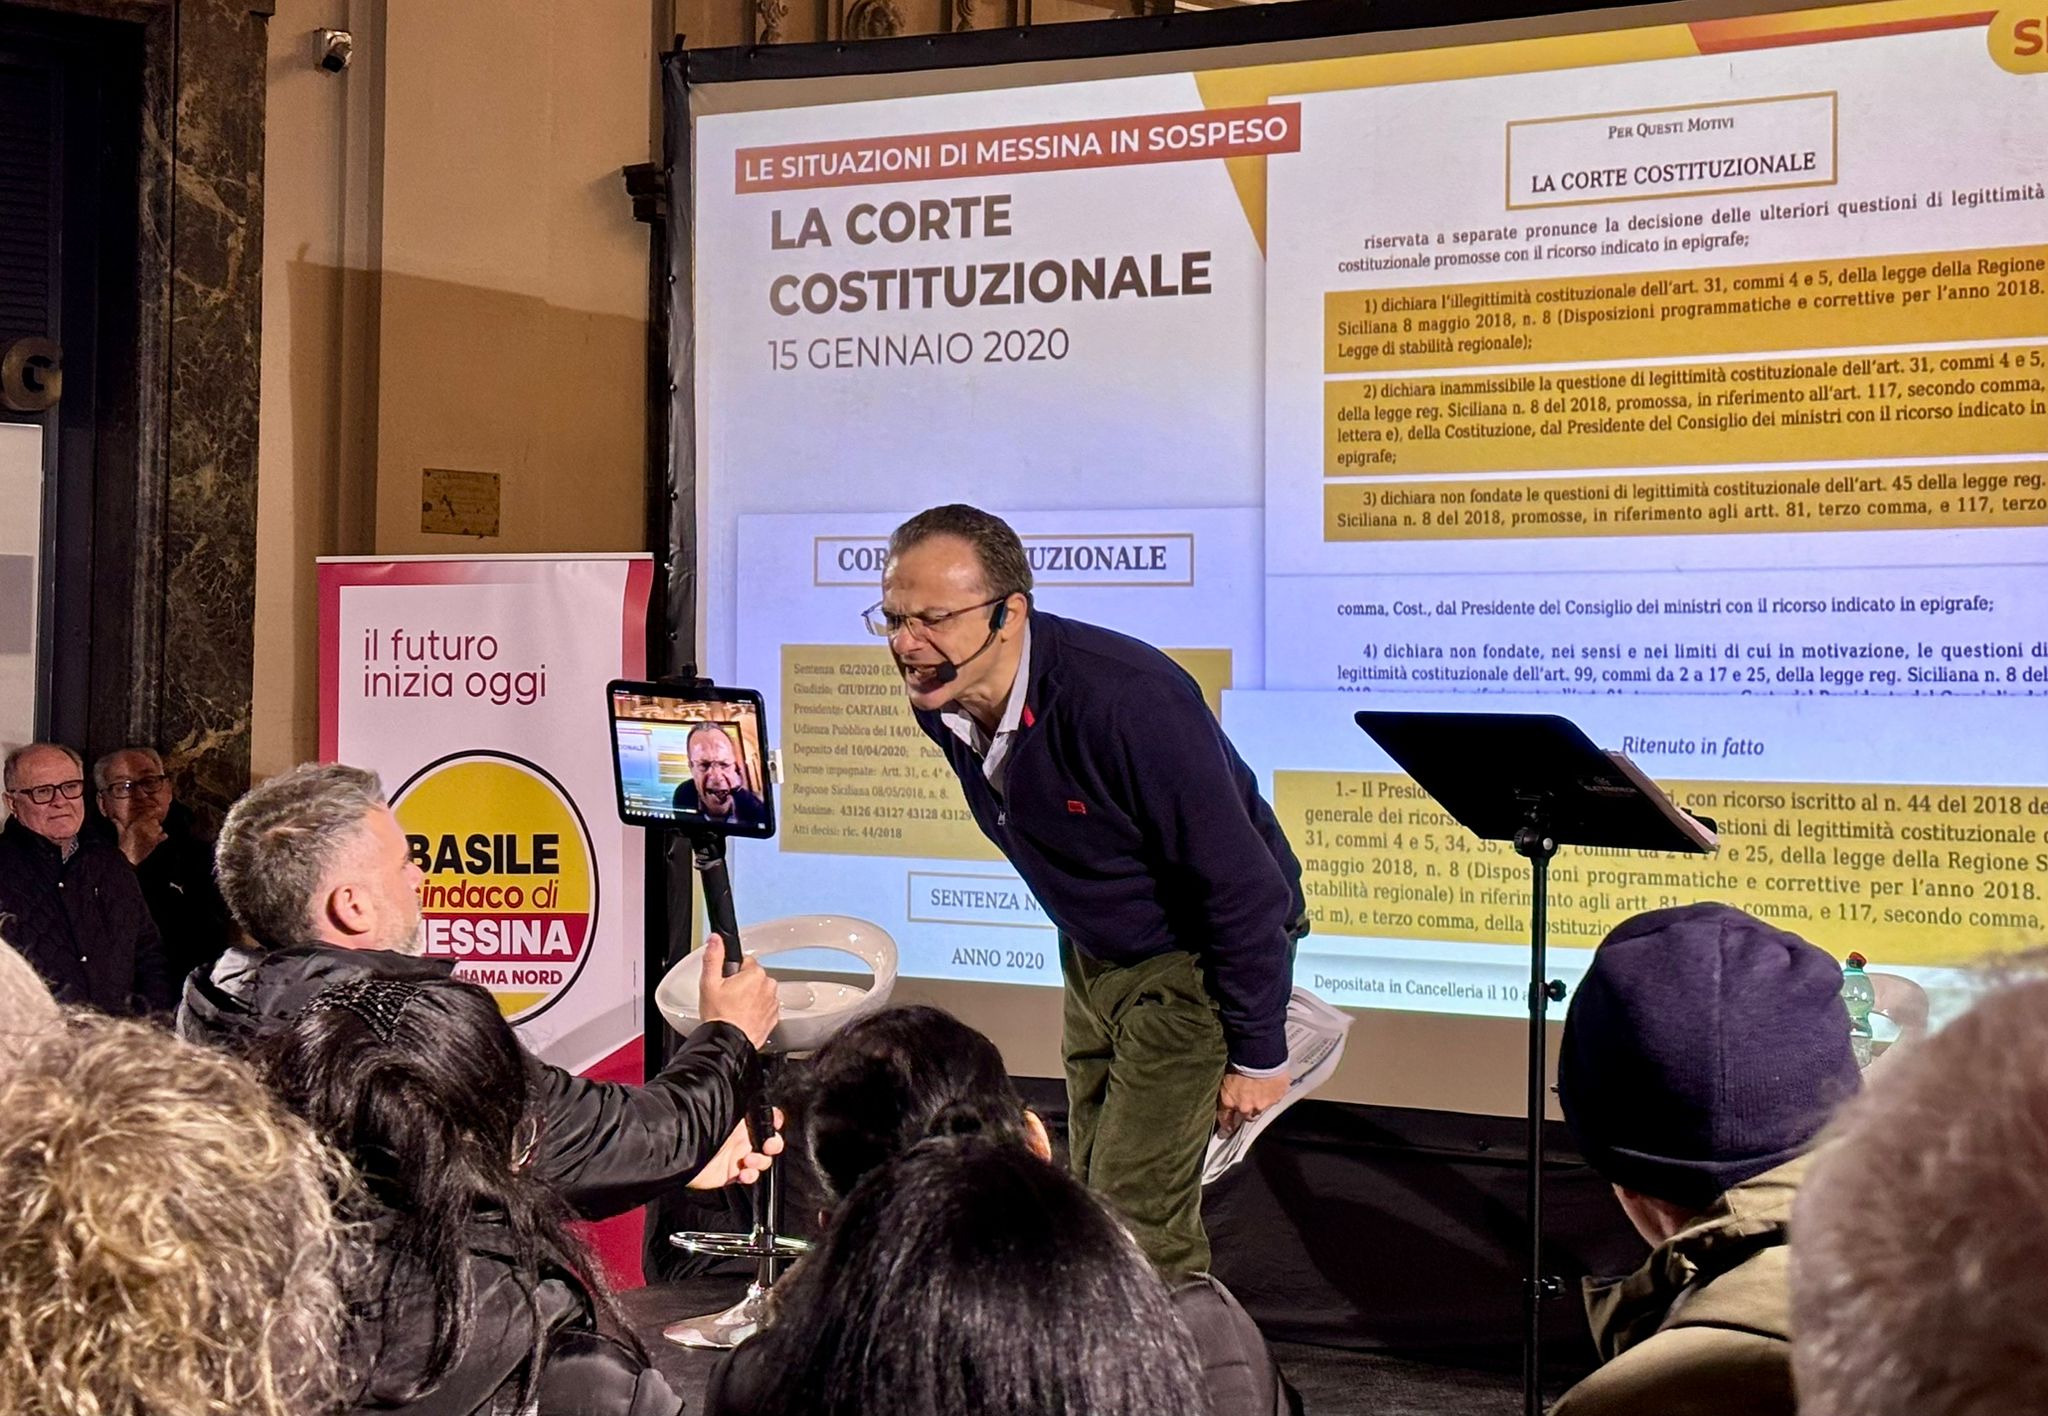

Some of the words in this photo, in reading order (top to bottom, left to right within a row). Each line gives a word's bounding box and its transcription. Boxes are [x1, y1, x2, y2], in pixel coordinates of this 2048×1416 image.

[745, 159, 774, 182] LE
[781, 144, 931, 180] SITUAZIONI
[939, 143, 967, 167] DI
[977, 131, 1102, 163] MESSINA
[1111, 129, 1139, 153] IN
[1148, 112, 1288, 150] SOSPESO
[1532, 175, 1555, 193] LA
[1562, 168, 1627, 190] CORTE
[1634, 152, 1815, 184] COSTITUZIONALE
[772, 208, 832, 250] LA
[846, 194, 1011, 245] CORTE
[1365, 234, 1429, 249] riservata
[1437, 234, 1444, 244] a
[1453, 227, 1517, 245] separate
[1526, 223, 1597, 241] pronunce
[1606, 217, 1619, 232] la
[1628, 213, 1703, 230] decisione
[1712, 207, 1751, 224] delle
[1761, 201, 1829, 221] ulteriori
[1838, 194, 1917, 218] questioni
[1927, 192, 1942, 207] di
[1952, 183, 2045, 208] legittimità
[1338, 253, 1430, 272] costituzionale
[1434, 252, 1500, 270] promosse
[1505, 250, 1529, 262] con
[1534, 245, 1542, 260] il
[1547, 245, 1596, 259] ricorso
[1601, 239, 1659, 255] indicato
[1664, 237, 1677, 251] in
[1682, 232, 1749, 252] epigrafe;
[770, 251, 1211, 315] COSTITUZIONALE
[1365, 299, 1377, 314] 1)
[1381, 297, 1436, 312] dichiara
[1442, 289, 1531, 310] l'illegittimità
[1536, 283, 1636, 303] costituzionale
[1641, 280, 1698, 296] dell'art.
[1705, 277, 1727, 293] 31,
[1733, 273, 1784, 290] commi
[1789, 272, 1798, 287] 4
[1804, 275, 1813, 286] e
[1819, 270, 1832, 286] 5,
[1838, 267, 1877, 283] della
[1883, 265, 1926, 284] legge
[1932, 261, 1971, 277] della
[1978, 257, 2045, 277] Regione
[1338, 320, 1397, 335] Siciliana
[1403, 318, 1412, 332] 8
[1419, 316, 1470, 333] maggio
[1476, 313, 1516, 328] 2018,
[1523, 315, 1536, 325] n.
[1543, 310, 1551, 324] 8
[1558, 304, 1655, 325] (Disposizioni
[1661, 296, 1791, 321] programmatiche
[1798, 298, 1807, 309] e
[1814, 290, 1894, 308] correttive
[1902, 290, 1931, 307] per
[1938, 285, 1989, 300] l'anno
[1997, 280, 2044, 296] 2018.
[769, 340, 797, 370] 15
[808, 333, 973, 369] GENNAIO
[984, 328, 1069, 362] 2020
[1339, 344, 1379, 360] Legge
[1382, 341, 1395, 356] di
[1400, 337, 1453, 355] stabilità
[1458, 334, 1532, 354] regionale);
[1364, 385, 1377, 399] 2)
[1381, 383, 1435, 397] dichiara
[1441, 377, 1535, 395] inammissibile
[1539, 376, 1552, 391] la
[1557, 374, 1626, 393] questione
[1631, 371, 1645, 386] di
[1649, 367, 1726, 389] legittimità
[1731, 362, 1837, 381] costituzionale
[1843, 360, 1904, 376] dell'art.
[1910, 357, 1934, 373] 31,
[1940, 354, 1994, 371] commi
[1999, 352, 2009, 368] 4
[2016, 355, 2025, 367] e
[2030, 351, 2044, 368] 5,
[1338, 449, 1396, 467] epigrafe;
[838, 548, 889, 571] COR
[1024, 546, 1167, 571] UZIONALE
[1338, 605, 1389, 616] comma,
[1393, 601, 1431, 616] Cost.,
[1436, 601, 1456, 615] dal
[1462, 600, 1535, 615] Presidente
[1539, 600, 1560, 615] del
[1565, 600, 1632, 618] Consiglio
[1637, 599, 1659, 614] dei
[1664, 599, 1721, 614] ministri
[1726, 602, 1753, 613] con
[1758, 598, 1767, 613] il
[1773, 598, 1826, 613] ricorso
[1832, 597, 1895, 612] indicato
[1900, 596, 1915, 611] in
[1920, 595, 1993, 615] epigrafe;
[365, 629, 377, 660] il
[391, 629, 497, 660] futuro
[840, 664, 879, 675] 62/2020
[365, 665, 452, 697] inizia
[466, 665, 545, 705] oggi
[837, 684, 887, 695] GIUDIZIO
[890, 685, 901, 696] DI
[846, 704, 898, 716] CARTABIA
[1622, 736, 1695, 754] Ritenuto
[1701, 738, 1716, 755] in
[1722, 737, 1764, 758] fatto
[840, 806, 870, 816] 43126
[873, 807, 904, 818] 43127
[907, 808, 938, 819] 43128
[405, 834, 560, 875] BASILE
[416, 879, 524, 909] indaco
[531, 879, 559, 909] di
[1306, 860, 1364, 876] maggio
[1372, 858, 1417, 877] 2018,
[1427, 864, 1440, 876] n.
[1450, 861, 1459, 877] 8
[1468, 862, 1579, 886] (Disposioni
[1587, 871, 1738, 888] programmatiche
[1747, 877, 1757, 889] e
[1766, 876, 1860, 893] correttive
[1871, 882, 1903, 899] per
[1912, 879, 1974, 897] l'anno
[1984, 881, 2040, 900] 2018.
[931, 889, 1019, 910] SENTENZA
[952, 948, 1001, 967] ANNO
[1007, 951, 1044, 969] 2020
[512, 969, 563, 985] NORD
[1315, 975, 1384, 993] Depositata
[1390, 980, 1402, 993] in
[1406, 980, 1483, 998] Cancelleria
[1488, 985, 1496, 1000] il
[1502, 987, 1518, 1001] 10
